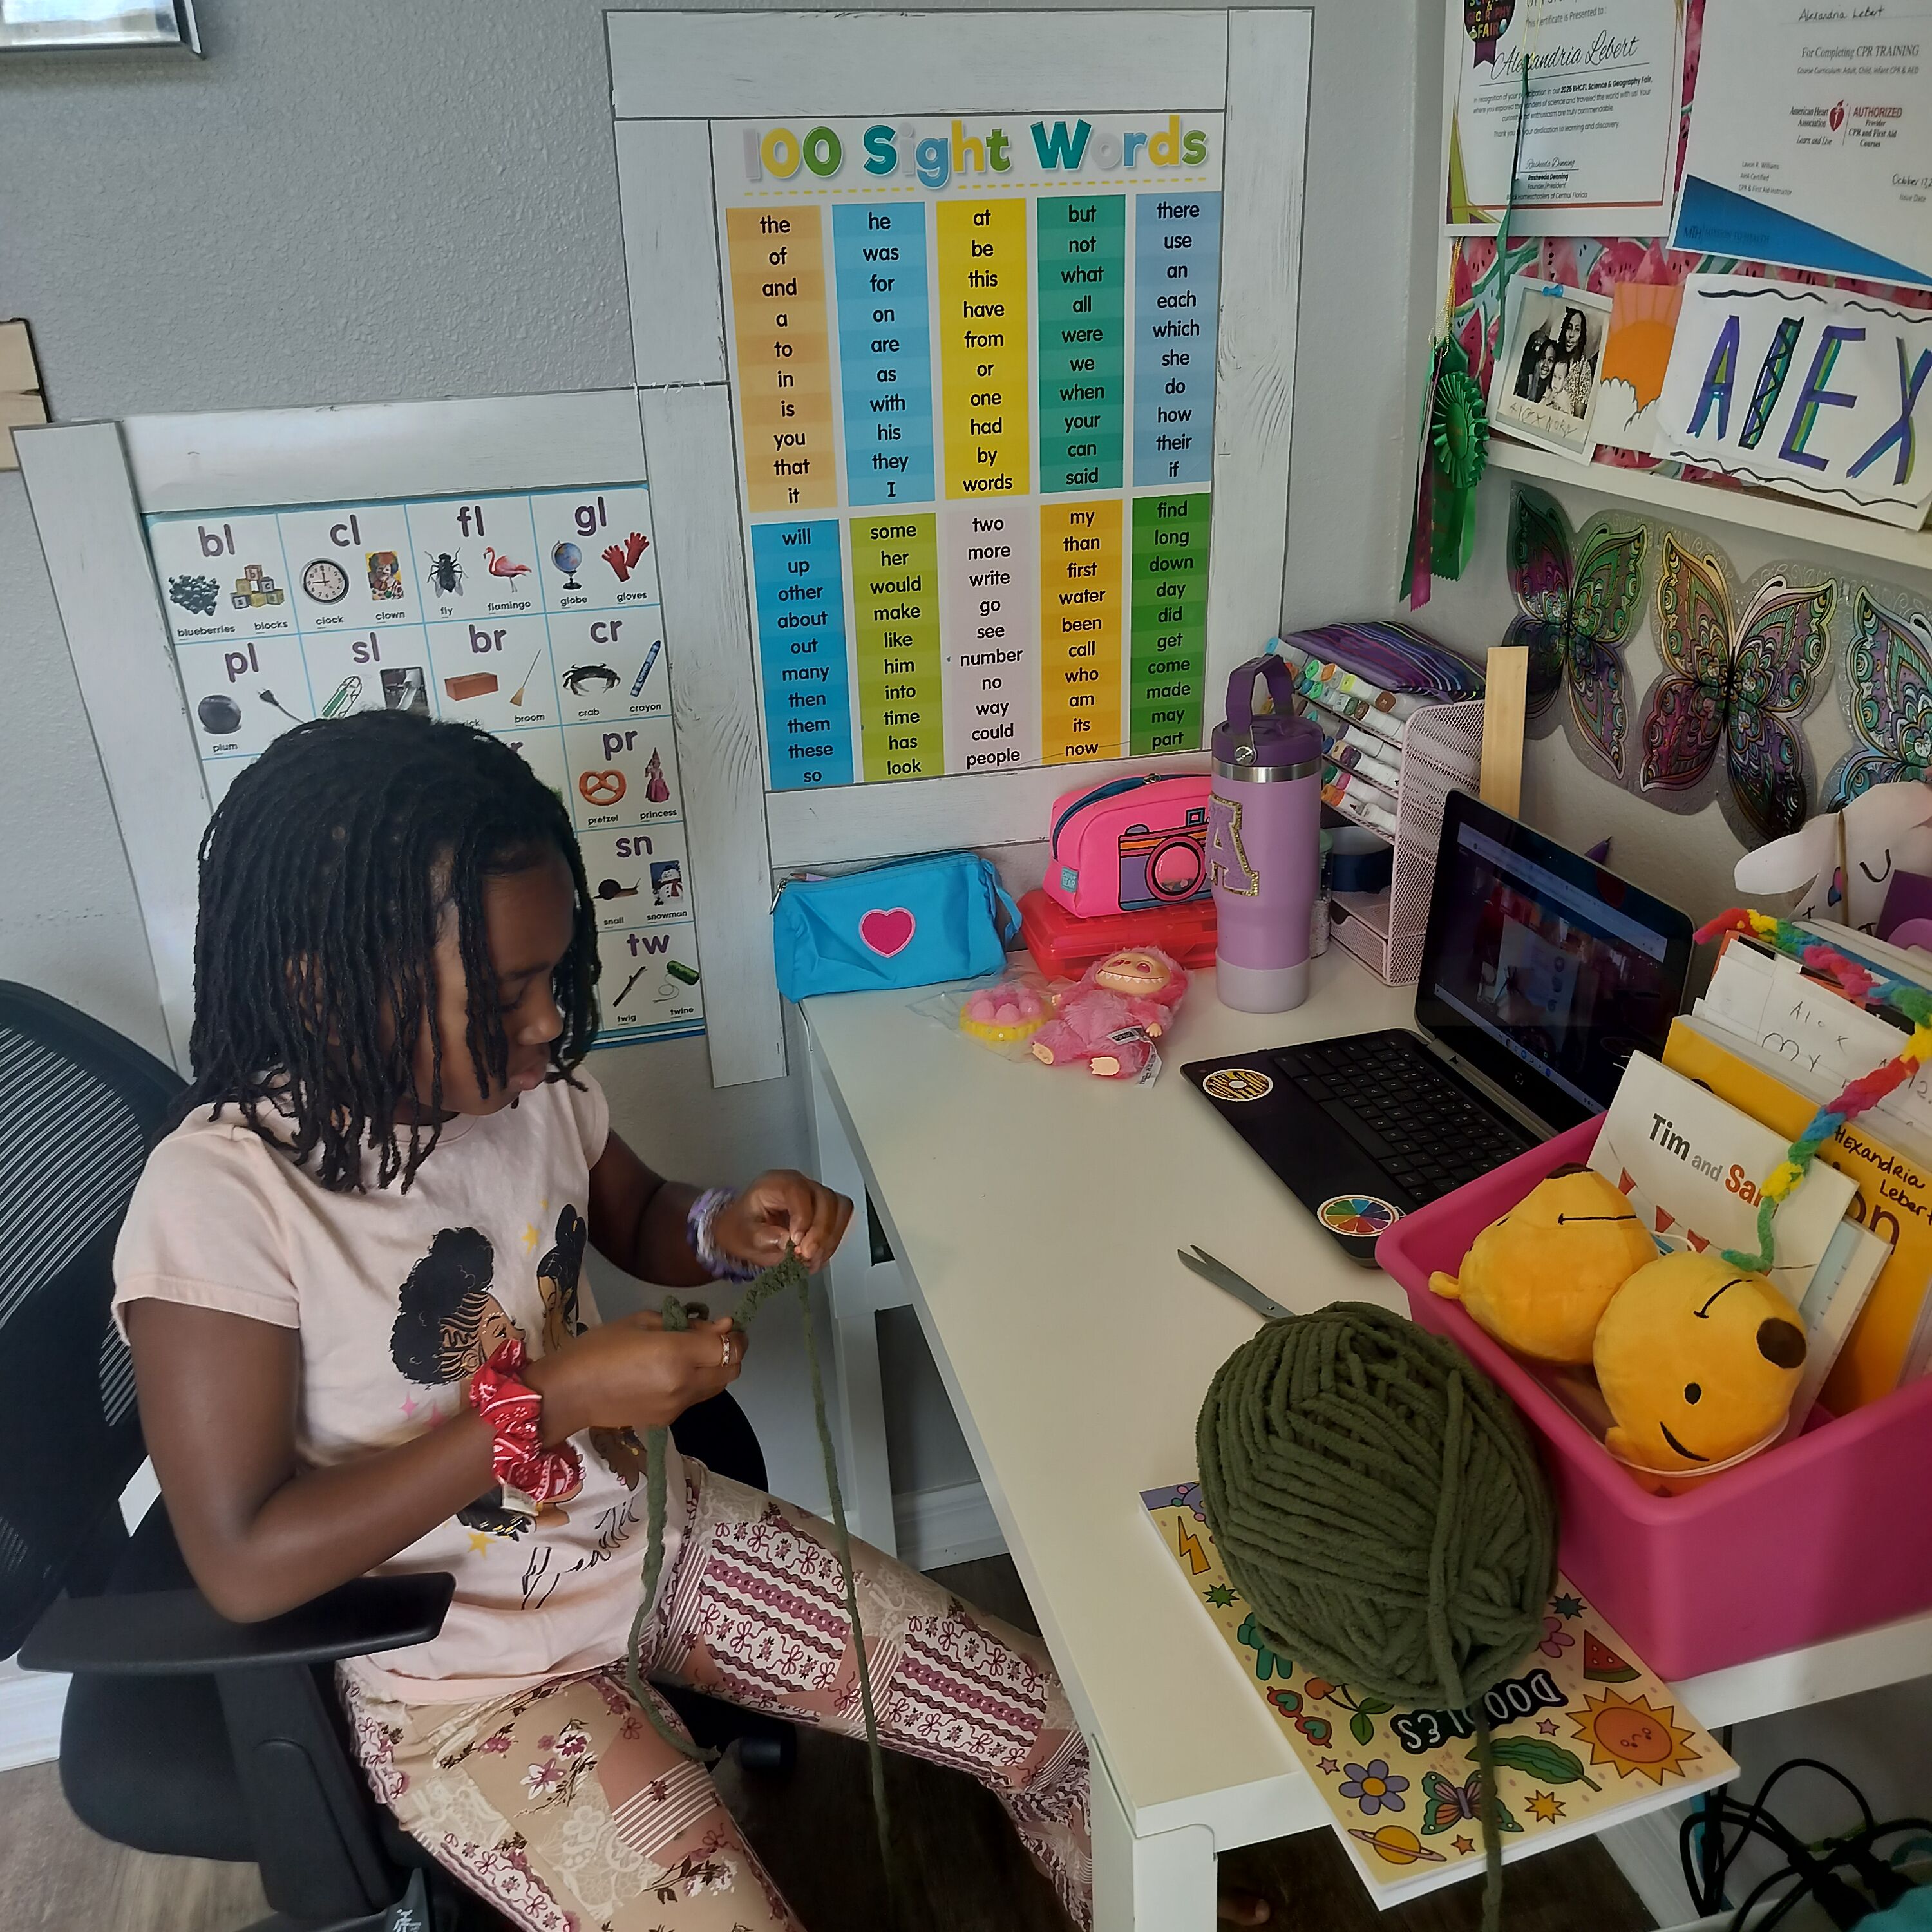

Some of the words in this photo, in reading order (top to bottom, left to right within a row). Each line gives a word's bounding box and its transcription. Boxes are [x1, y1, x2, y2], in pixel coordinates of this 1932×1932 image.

[1569, 9, 1597, 21] Presented
[1799, 8, 1847, 21] Alexandria
[1585, 30, 1640, 65] Lebert
[1801, 46, 1814, 58] For
[1815, 46, 1855, 60] Completing
[1856, 46, 1873, 57] CPR
[1875, 44, 1920, 57] TRAINING
[1588, 81, 1607, 90] Science
[1613, 77, 1641, 90] Geography
[1790, 106, 1813, 116] American
[1814, 106, 1828, 116] Heart
[1853, 106, 1902, 118] AUTHORIZED
[743, 125, 842, 180] 100
[862, 120, 1012, 189] Sight
[1030, 115, 1208, 171] Words
[1068, 204, 1097, 223] but
[1156, 200, 1200, 219] there
[759, 214, 791, 234] the
[1069, 236, 1097, 253] not
[1164, 235, 1192, 249] use
[862, 247, 899, 261] was
[869, 274, 895, 292] for
[967, 269, 998, 288] this
[1061, 265, 1104, 284] what
[762, 277, 797, 297] and
[1072, 294, 1092, 313] all
[1157, 289, 1197, 309] each
[963, 301, 1005, 319] have
[1061, 328, 1103, 343] were
[1152, 319, 1200, 338] which
[871, 339, 900, 353] are
[963, 330, 1004, 348] from
[1161, 348, 1190, 366] she
[970, 392, 1002, 406] one
[1059, 383, 1104, 401] when
[869, 393, 905, 412] with
[1157, 406, 1192, 424] how
[877, 423, 901, 441] his
[971, 416, 1002, 435] had
[1064, 415, 1101, 434] your
[773, 433, 806, 451] you
[1067, 444, 1097, 457] can
[1155, 433, 1193, 451] their
[773, 459, 810, 476] that
[871, 453, 909, 473] they
[962, 473, 1013, 492] words
[1066, 466, 1099, 485] said
[574, 496, 607, 536] gl
[1157, 500, 1188, 518] find
[330, 514, 361, 546] cl
[457, 506, 485, 537] fl
[972, 517, 1004, 533] two
[198, 524, 235, 557] bl
[782, 527, 811, 545] will
[870, 525, 917, 540] some
[1155, 529, 1189, 547] long
[968, 545, 1011, 560] more
[1063, 535, 1100, 553] than
[880, 550, 909, 567] her
[1149, 556, 1193, 572] down
[969, 569, 1010, 587] write
[1066, 562, 1098, 578] first
[778, 584, 824, 601] other
[869, 574, 922, 594] would
[1156, 581, 1186, 600] day
[488, 600, 531, 611] flamingo
[560, 595, 587, 606] globe
[617, 591, 647, 603] gloves
[1059, 589, 1106, 605] water
[375, 611, 405, 620] clown
[440, 606, 453, 616] fly
[873, 603, 921, 621] make
[1158, 605, 1182, 623] did
[254, 620, 288, 630] blocks
[316, 616, 344, 625] clock
[777, 611, 828, 629] about
[1062, 617, 1102, 632] been
[178, 625, 236, 638] blueberries
[469, 624, 507, 654] br
[590, 620, 623, 643] cr
[884, 631, 913, 648] like
[976, 626, 1005, 639] see
[352, 632, 381, 663] sl
[790, 638, 819, 654] out
[1068, 640, 1095, 658] call
[1157, 632, 1184, 652] get
[225, 643, 259, 683] pl
[960, 648, 1023, 667] number
[782, 667, 829, 682] many
[884, 658, 915, 675] him
[1065, 667, 1099, 683] who
[1148, 659, 1191, 674] come
[885, 685, 916, 700] into
[1146, 681, 1191, 699] made
[629, 703, 661, 712] crayon
[788, 692, 826, 708] then
[515, 713, 545, 723] broom
[578, 708, 600, 717] crab
[883, 710, 920, 726] time
[975, 702, 1009, 717] way
[1151, 710, 1186, 726] may
[787, 718, 831, 734] them
[971, 722, 1014, 741] could
[213, 741, 238, 752] plum
[603, 729, 638, 761] pr
[888, 735, 918, 750] has
[1152, 731, 1184, 750] part
[788, 743, 833, 759] these
[967, 747, 1020, 770] people
[1065, 743, 1099, 757] now
[887, 758, 922, 775] look
[588, 814, 618, 826] pretzel
[640, 808, 677, 820] princess
[616, 835, 652, 858] sn
[1205, 790, 1259, 896] A
[604, 916, 624, 926] snail
[647, 909, 687, 921] snowman
[627, 933, 670, 957] tw
[618, 1012, 636, 1024] twig
[670, 1006, 694, 1016] twine
[1649, 1113, 1690, 1161] Tim
[1691, 1155, 1723, 1182] and
